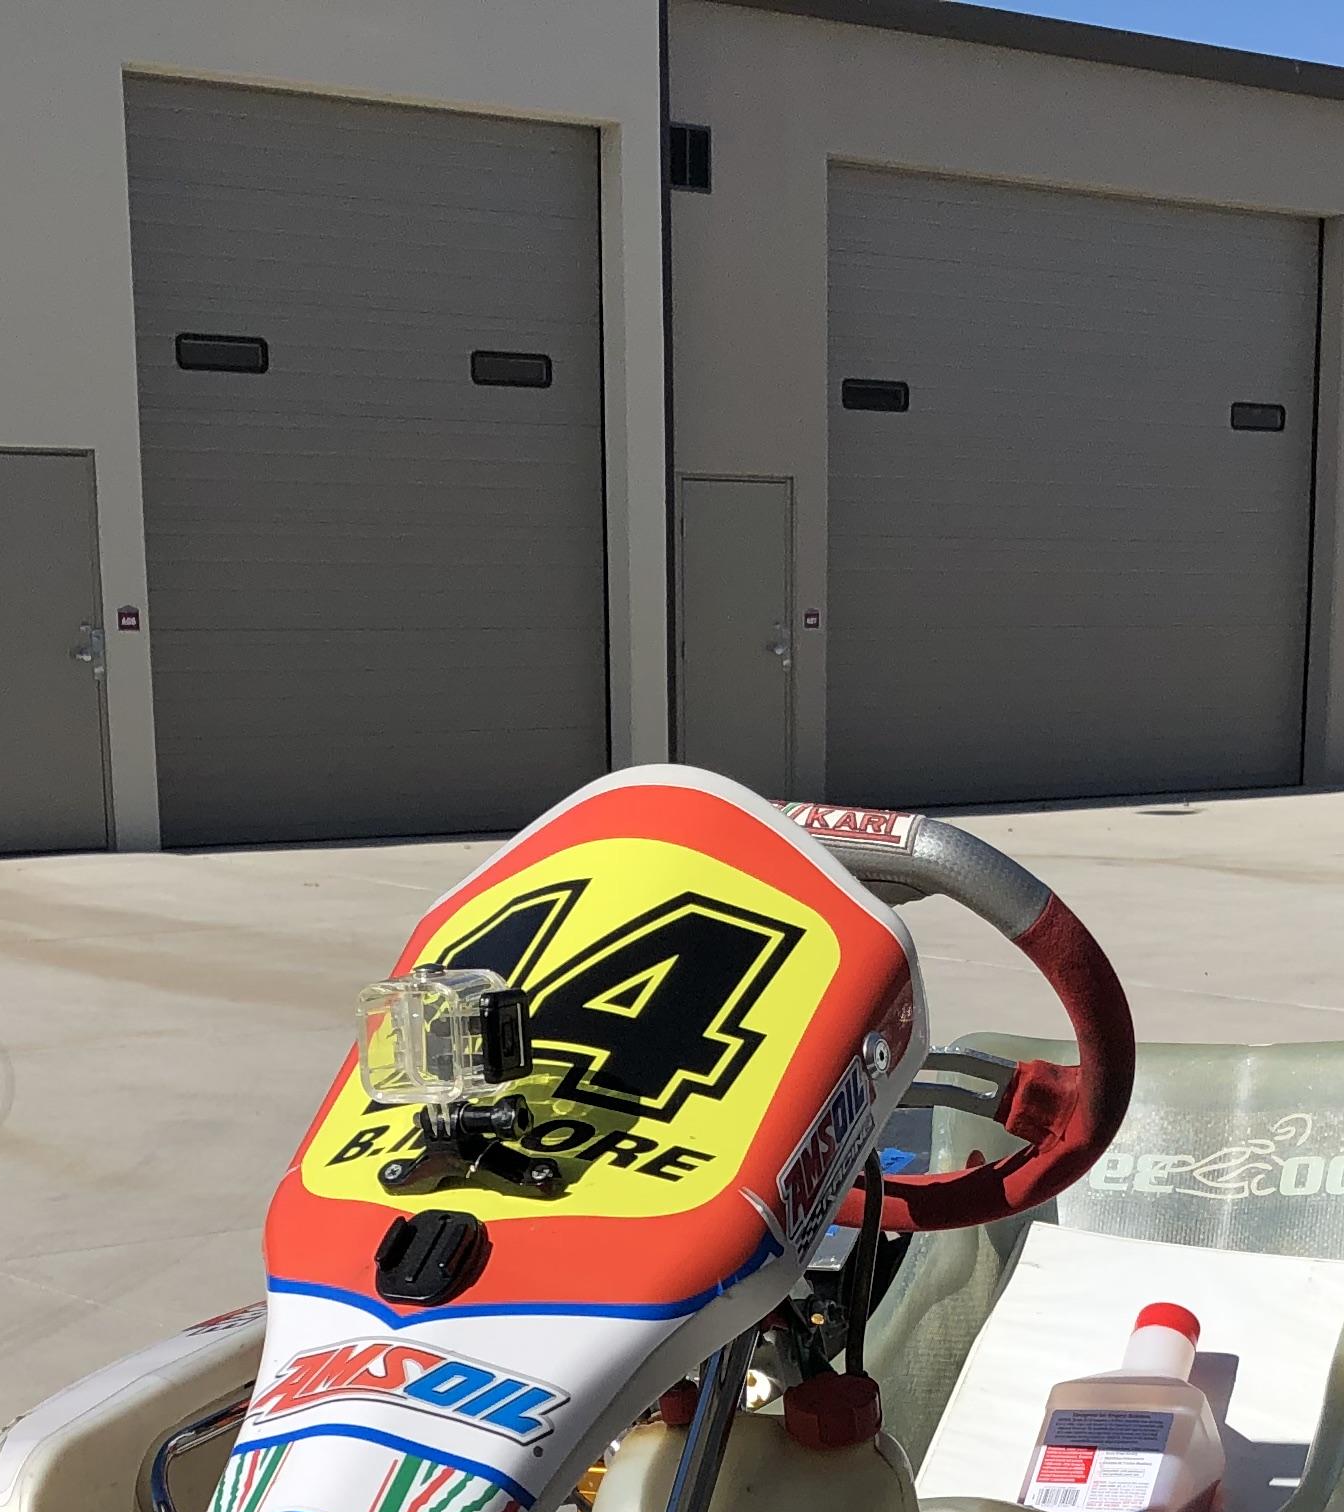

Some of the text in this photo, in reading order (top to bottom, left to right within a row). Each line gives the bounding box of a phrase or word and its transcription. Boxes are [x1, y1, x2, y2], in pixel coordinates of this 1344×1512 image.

[325, 1118, 717, 1183] B.ORE
[782, 1065, 871, 1232] AMSOIL
[250, 1342, 557, 1435] AMSOIL
